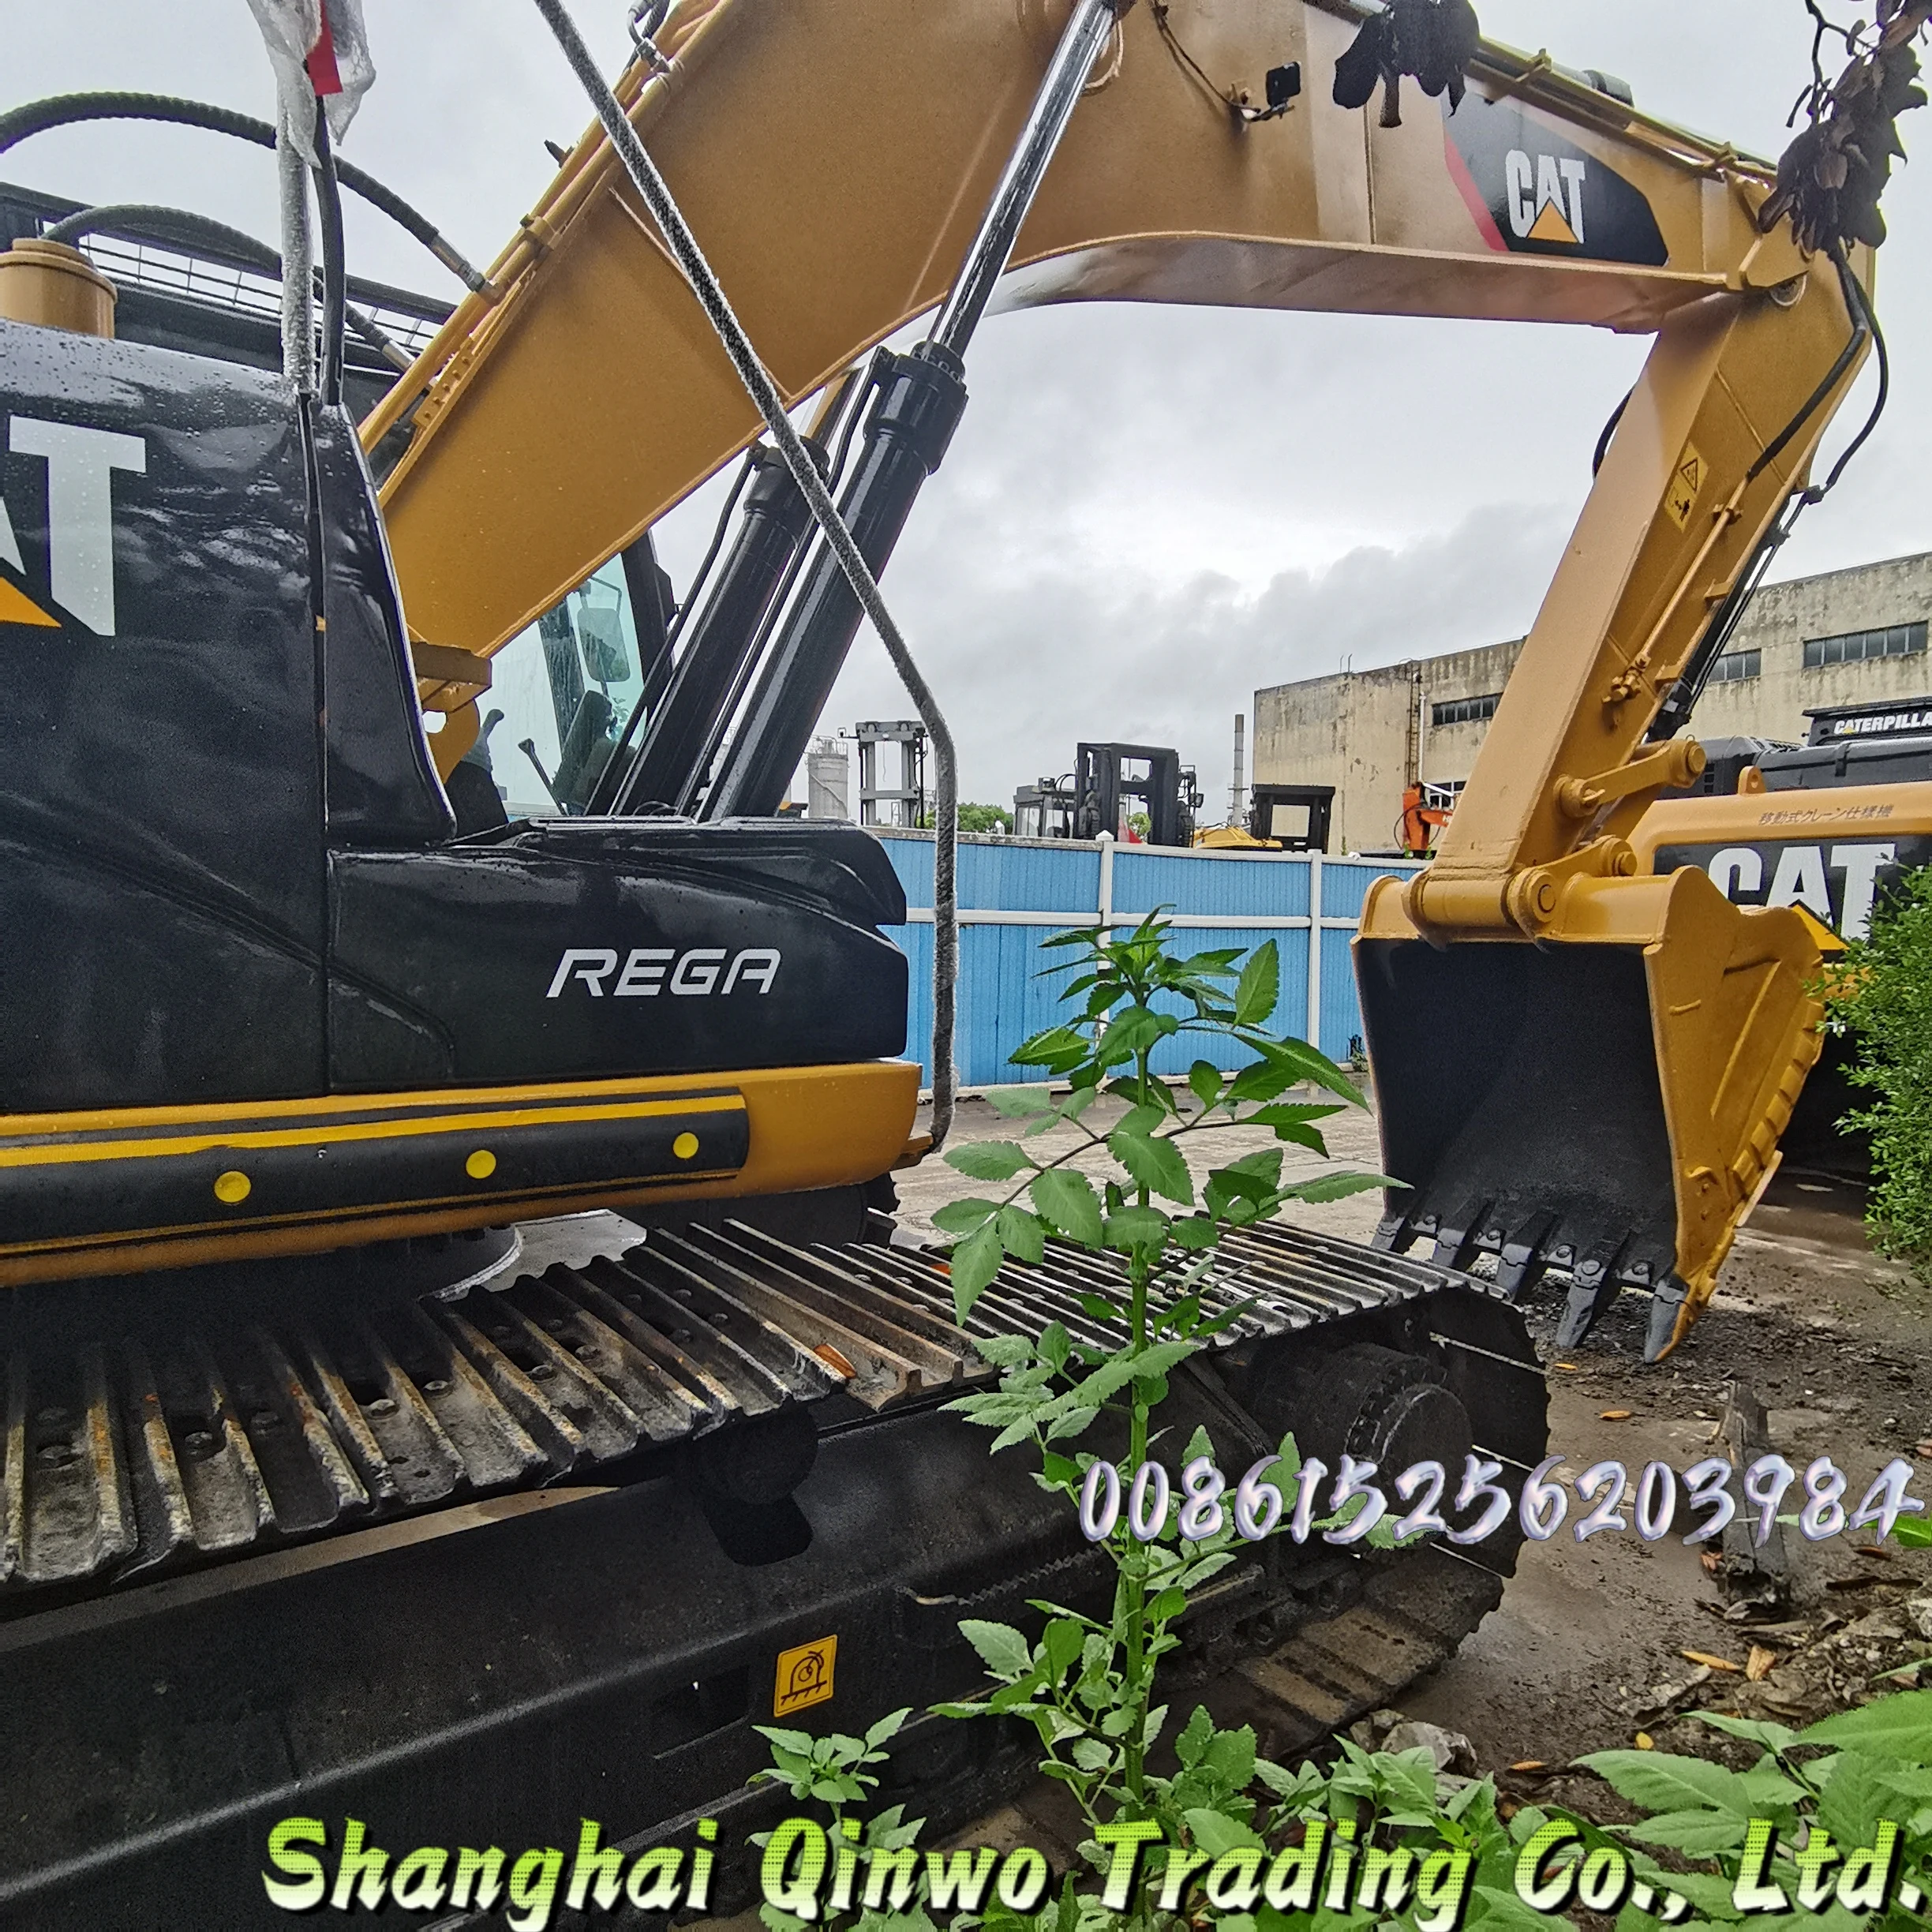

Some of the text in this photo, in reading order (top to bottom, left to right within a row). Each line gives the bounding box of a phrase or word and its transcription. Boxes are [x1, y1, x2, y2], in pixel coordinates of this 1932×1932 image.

[1505, 149, 1586, 244] CAT
[0, 415, 146, 636] T
[1709, 844, 1895, 942] CAT
[545, 949, 781, 998] REGA
